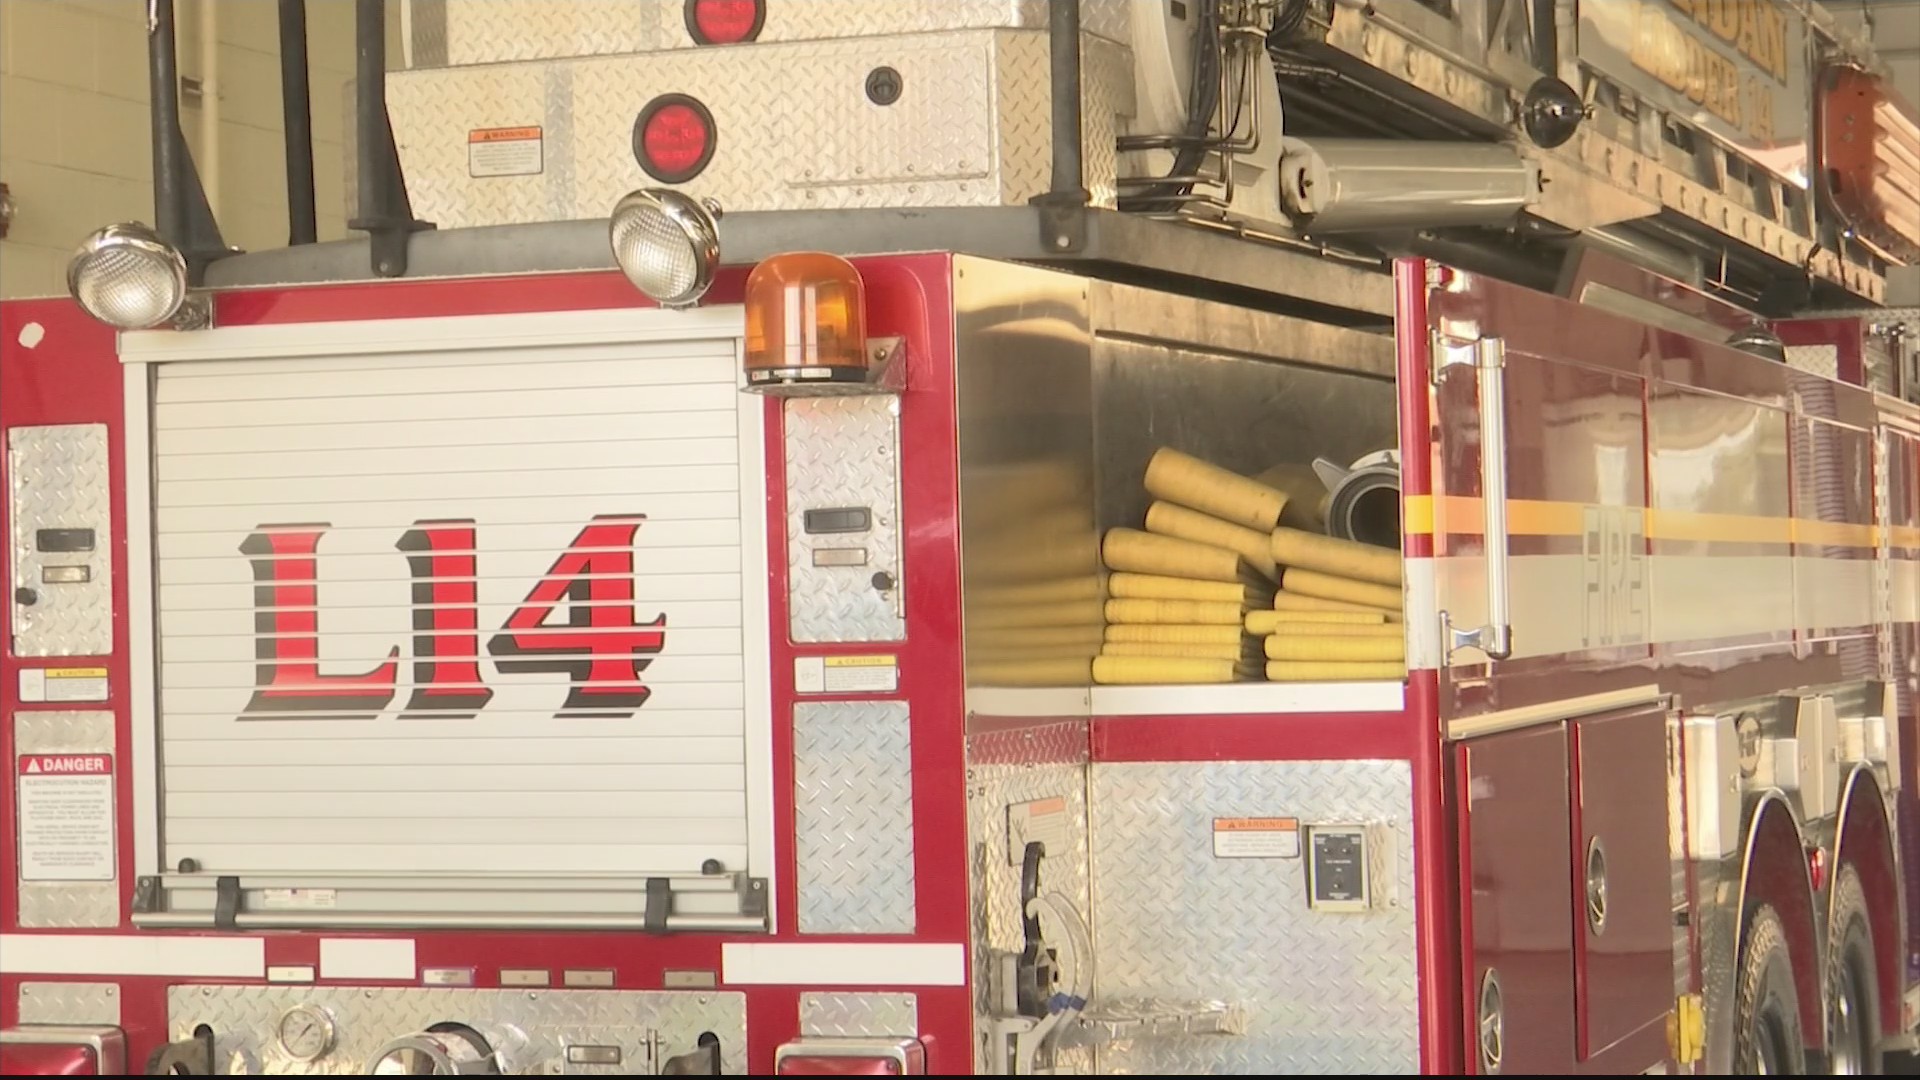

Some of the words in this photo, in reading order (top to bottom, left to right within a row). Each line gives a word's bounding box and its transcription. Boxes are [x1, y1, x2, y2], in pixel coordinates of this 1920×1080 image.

[1582, 505, 1643, 648] FIRE
[235, 513, 667, 721] L14
[43, 758, 105, 772] DANGER
[1238, 821, 1284, 829] WARNING
